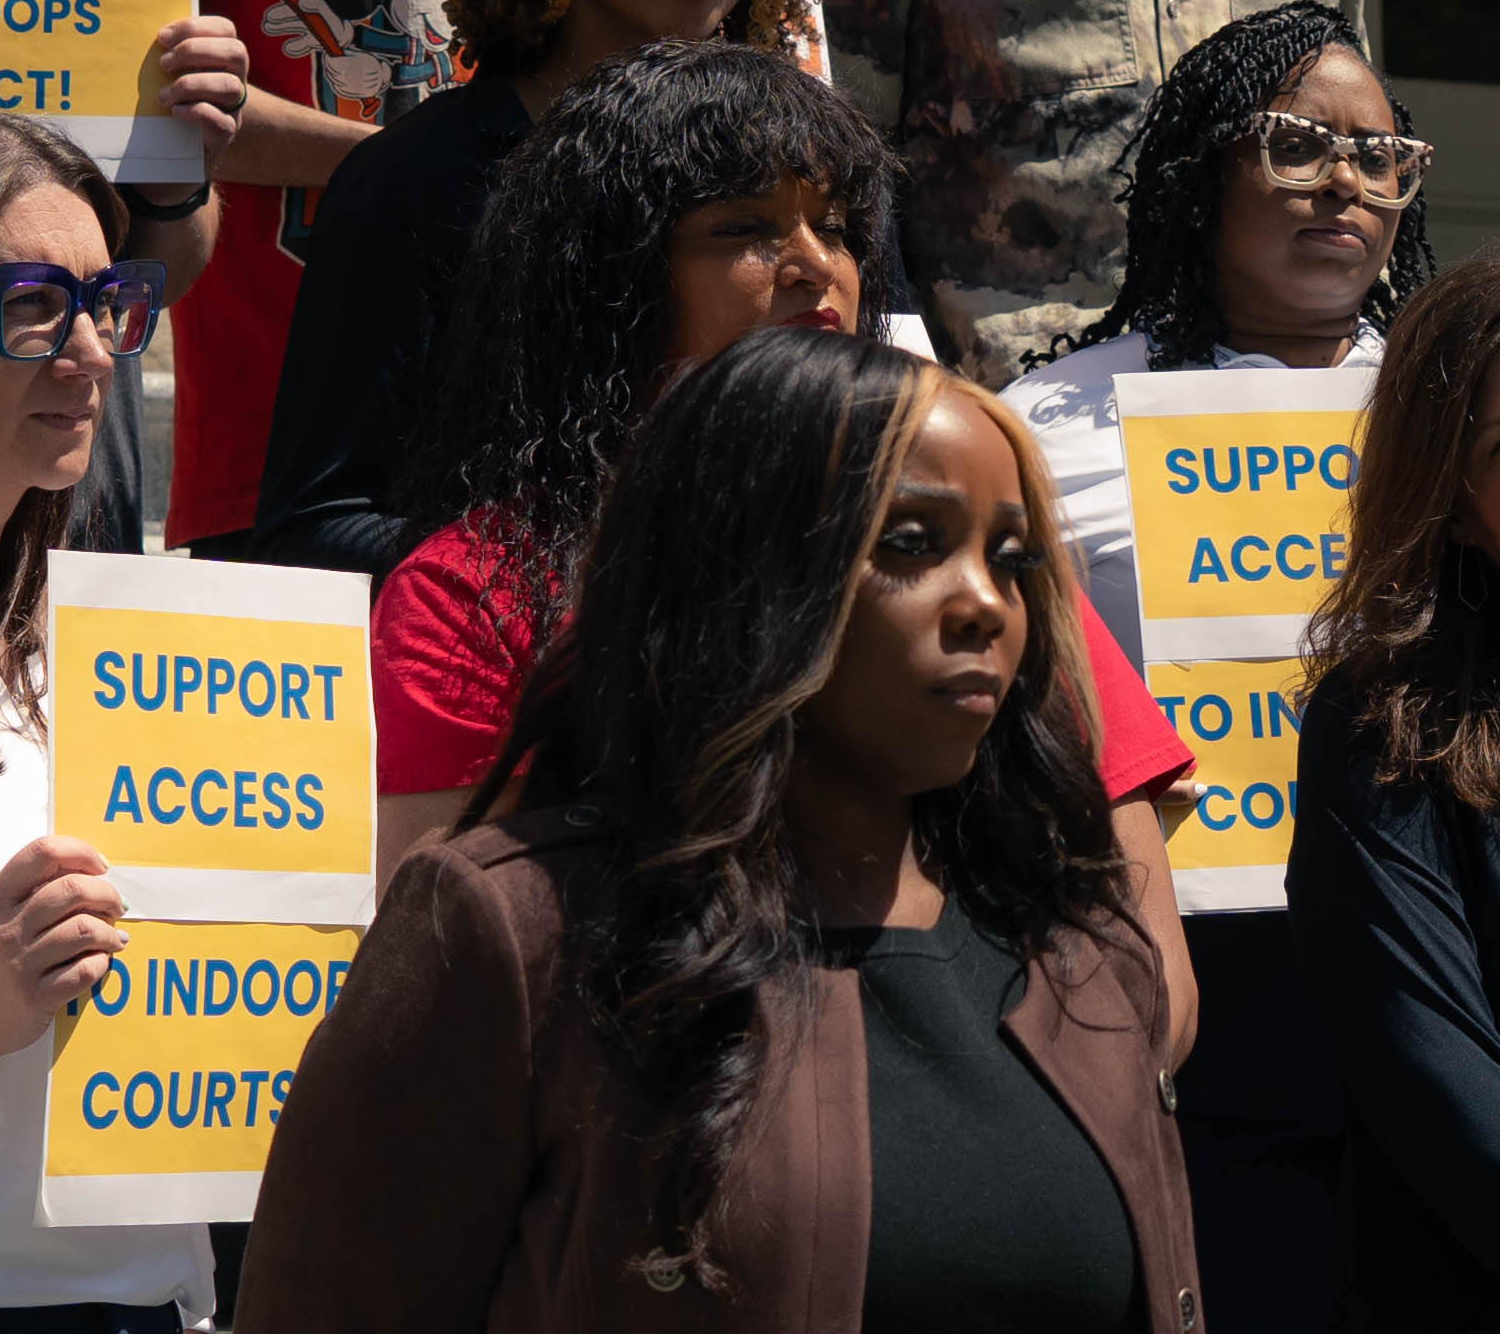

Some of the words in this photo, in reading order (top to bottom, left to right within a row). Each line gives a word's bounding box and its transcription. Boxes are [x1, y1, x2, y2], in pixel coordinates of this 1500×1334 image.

[94, 650, 343, 722] SUPPORT
[1155, 693, 1233, 742] TO
[103, 765, 325, 831] ACCESS
